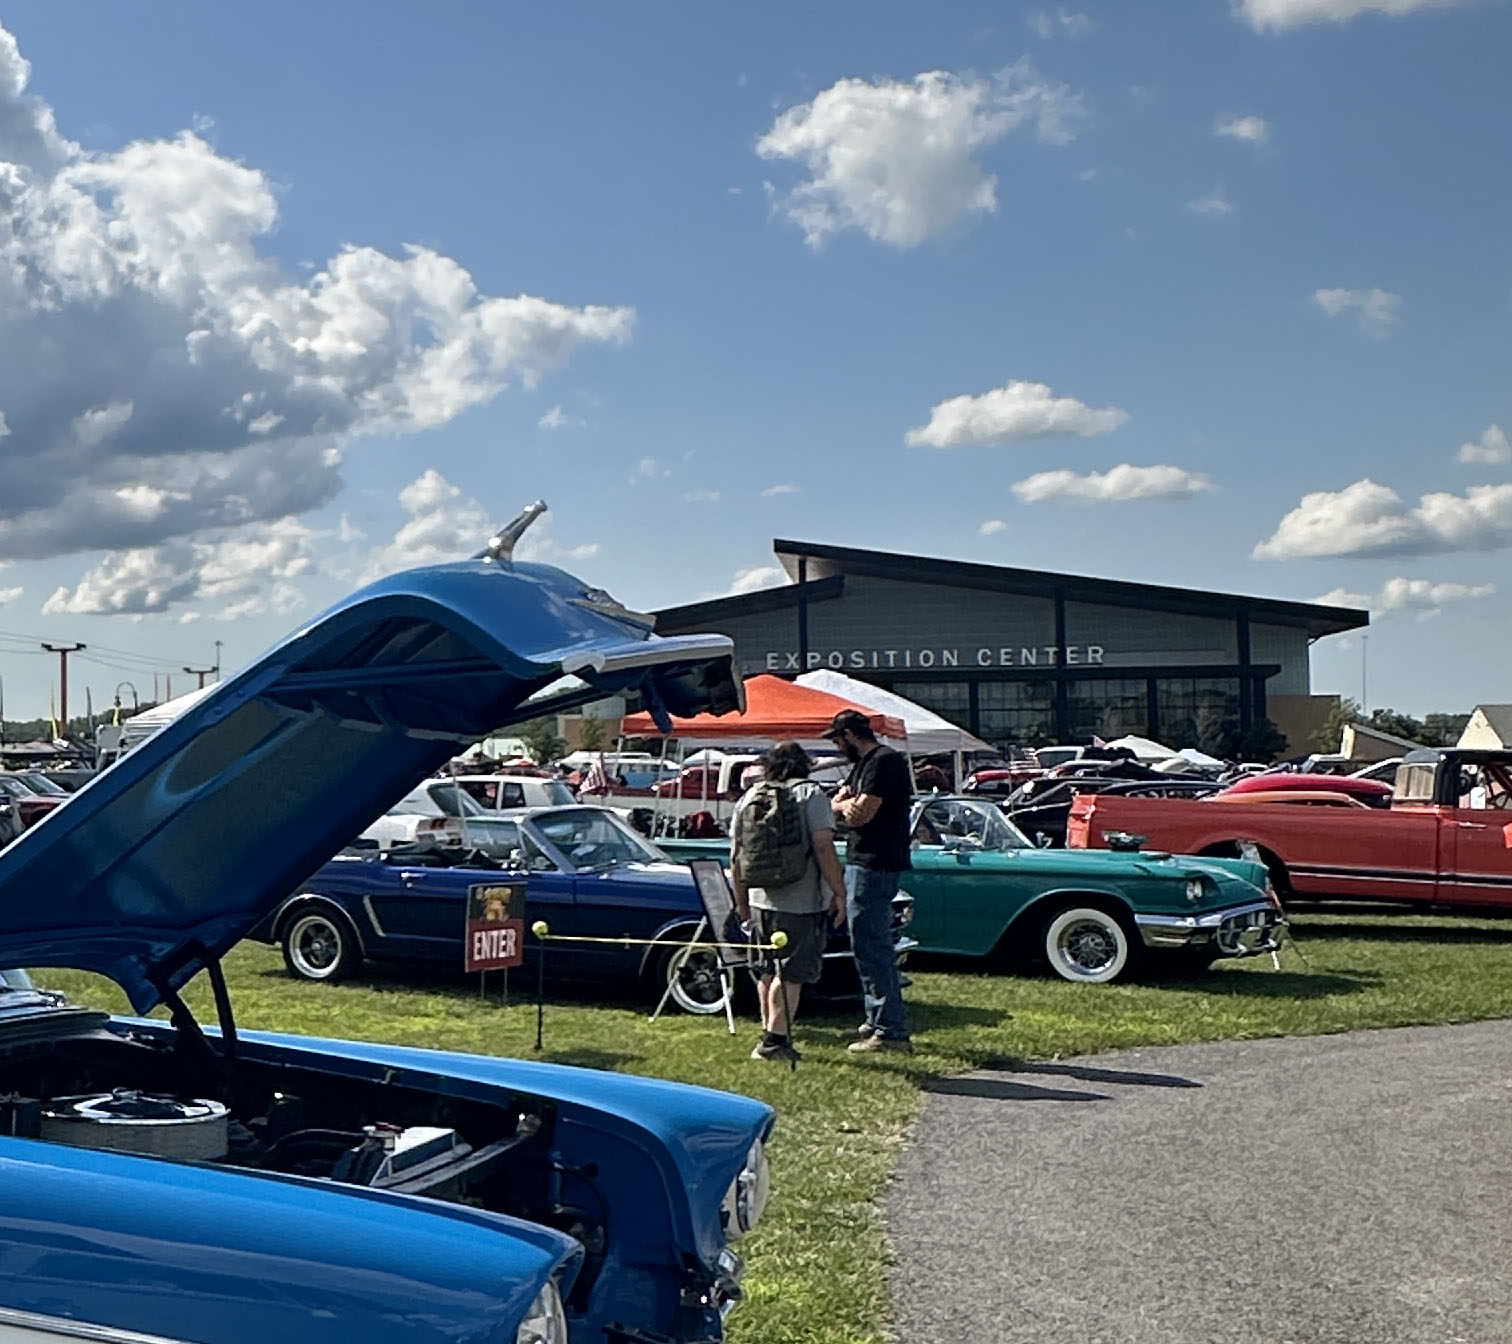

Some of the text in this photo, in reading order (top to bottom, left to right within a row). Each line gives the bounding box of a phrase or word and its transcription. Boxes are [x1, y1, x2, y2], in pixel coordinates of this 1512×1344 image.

[766, 646, 1105, 670] EXPOSITION CENTER
[473, 928, 516, 961] ENTER
